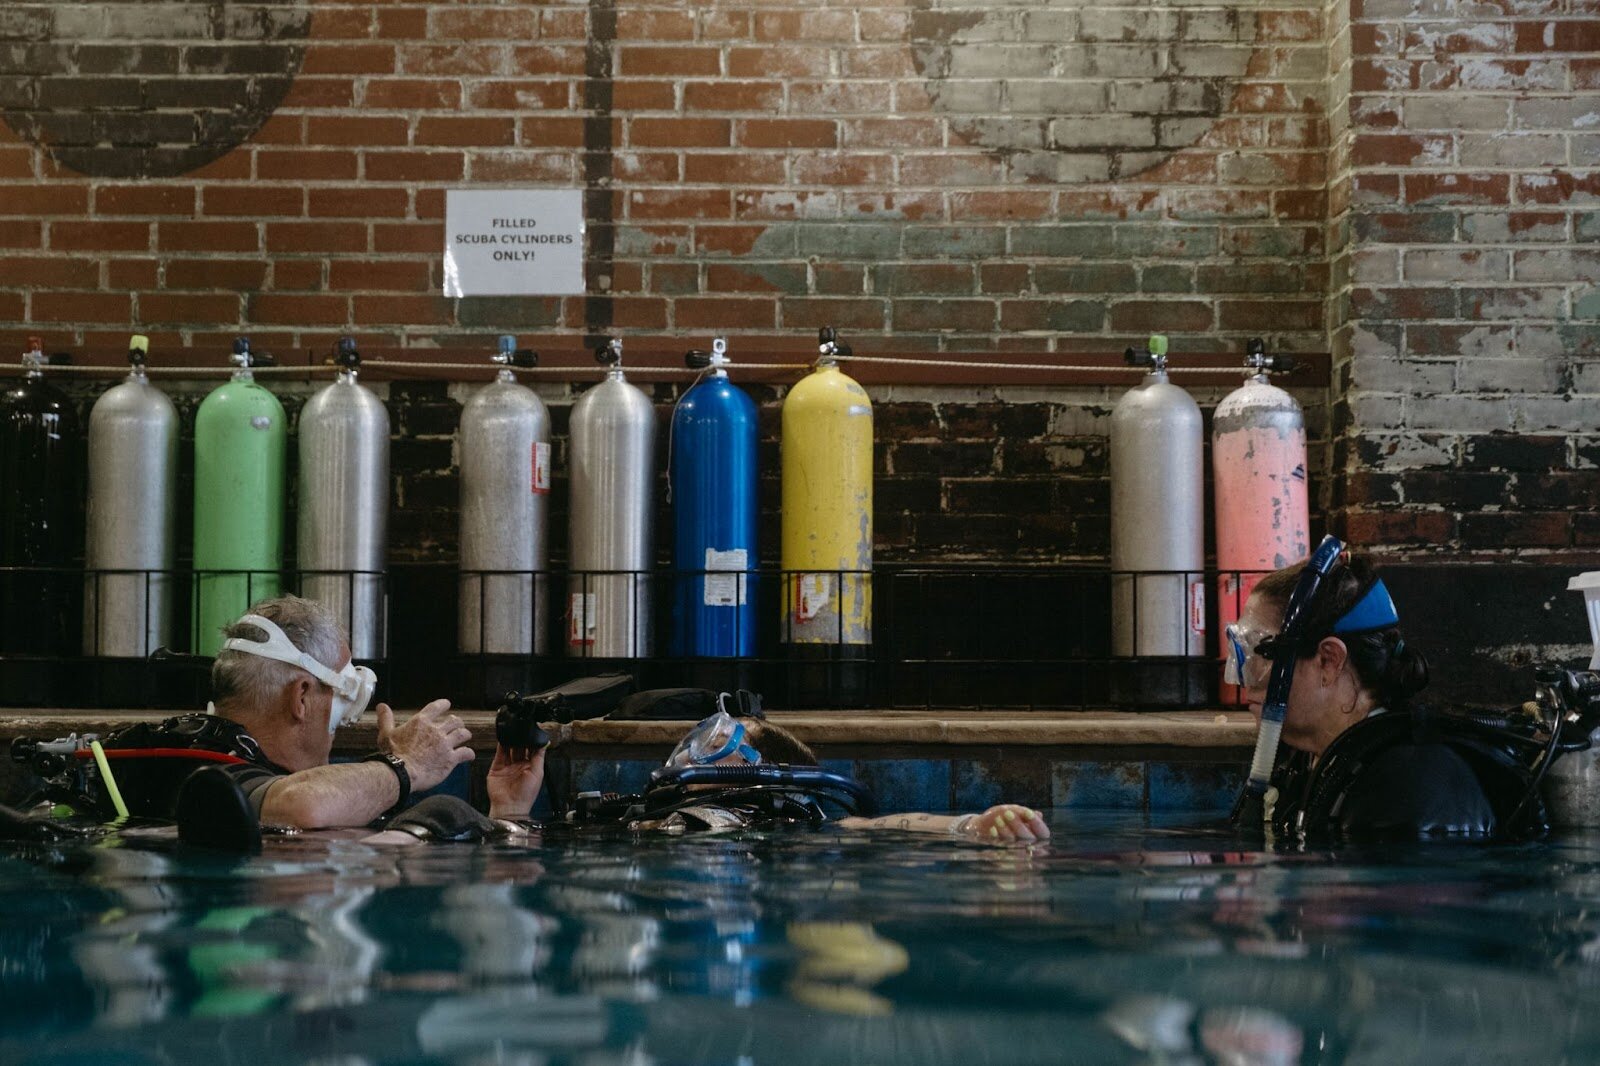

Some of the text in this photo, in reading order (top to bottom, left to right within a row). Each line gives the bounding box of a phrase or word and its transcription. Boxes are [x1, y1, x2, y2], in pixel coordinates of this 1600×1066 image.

[492, 218, 537, 228] FILLED
[455, 234, 574, 244] SCUBA CYLINDERS
[492, 250, 535, 261] ONLY!
